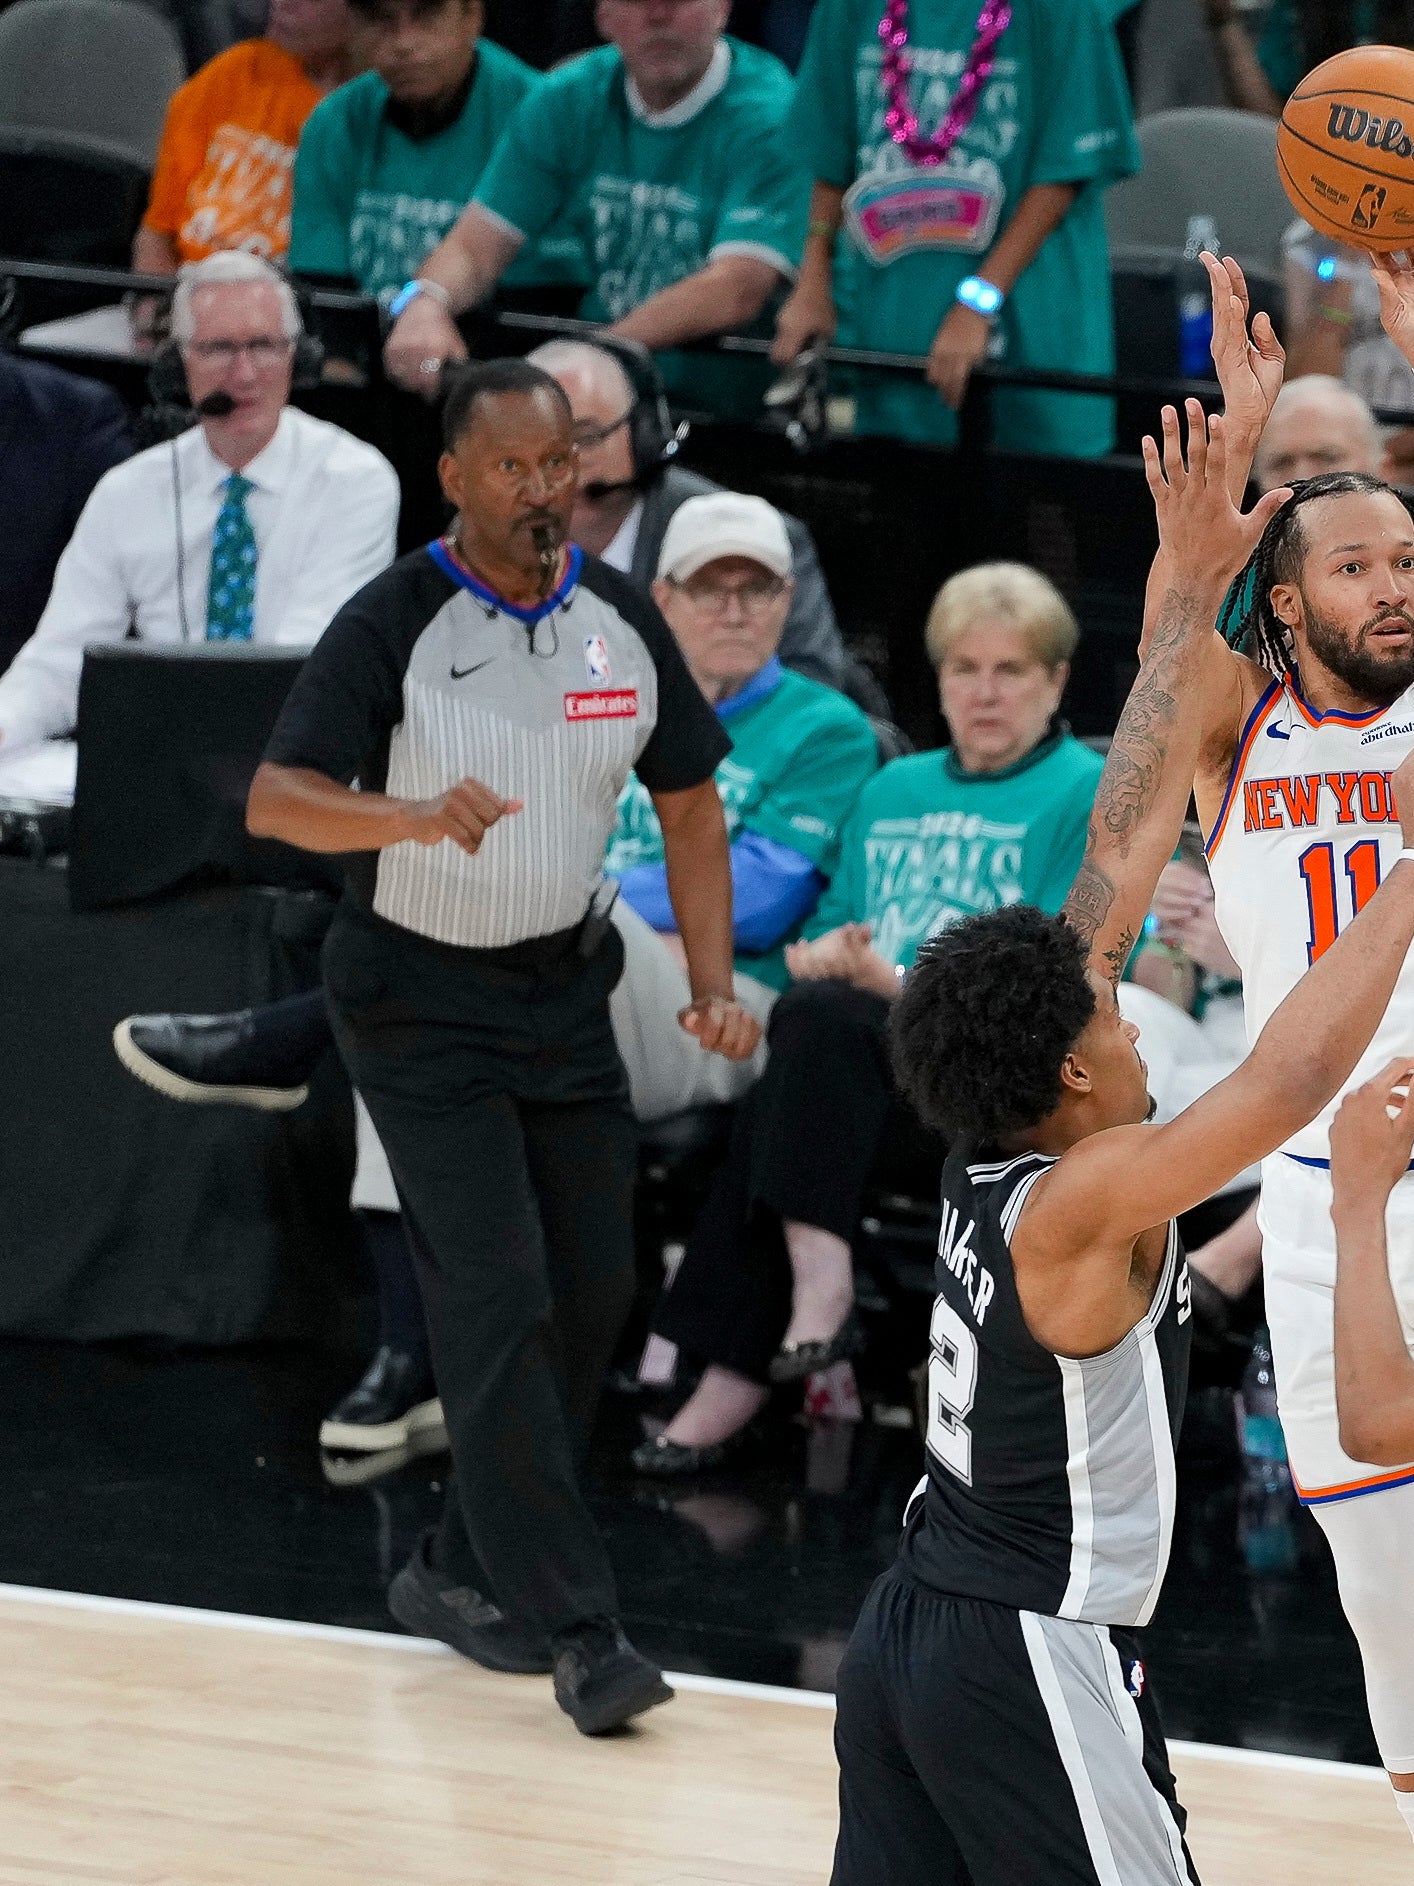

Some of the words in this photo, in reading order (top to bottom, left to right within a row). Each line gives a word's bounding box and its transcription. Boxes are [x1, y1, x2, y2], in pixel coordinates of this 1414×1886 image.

[1360, 731, 1384, 746] abu
[1361, 721, 1392, 737] experience
[1243, 772, 1323, 835] NEW
[1322, 769, 1401, 825] YO
[1297, 838, 1382, 971] 11
[926, 1291, 979, 1488] 2
